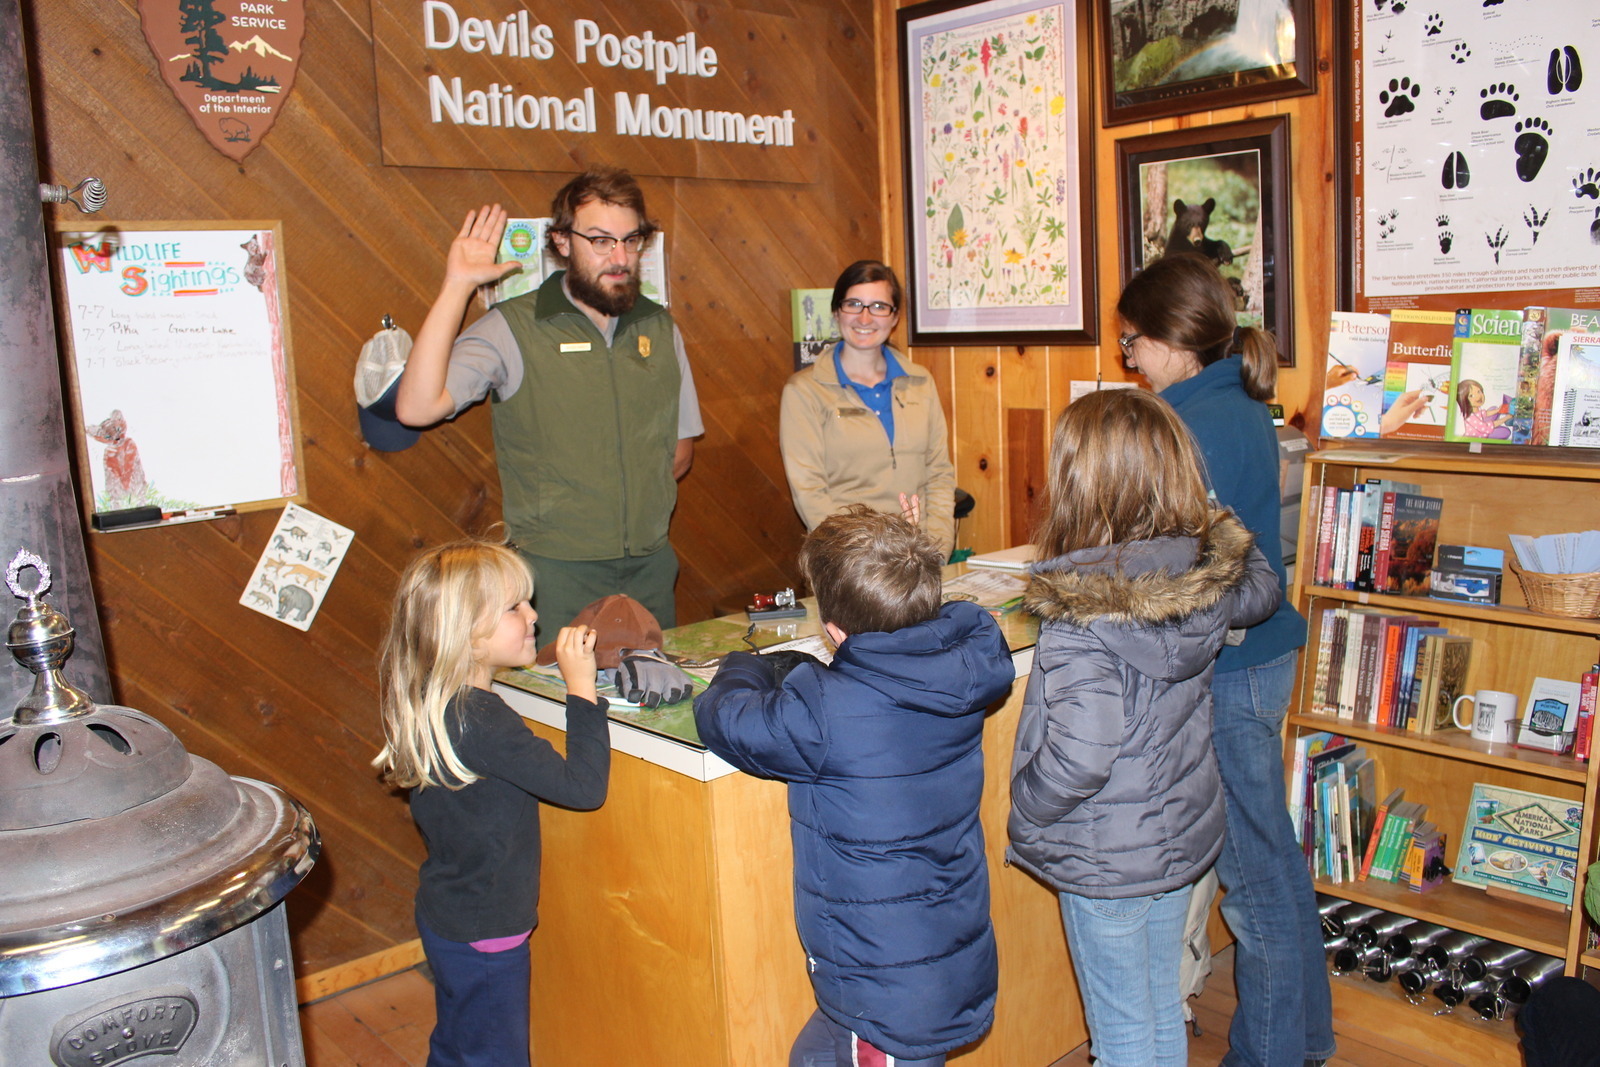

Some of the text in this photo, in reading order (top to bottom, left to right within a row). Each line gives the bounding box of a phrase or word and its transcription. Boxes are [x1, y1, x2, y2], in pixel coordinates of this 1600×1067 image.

[240, 3, 275, 15] PARK
[231, 16, 287, 30] SERVICE
[422, 0, 719, 86] Devils Postpile
[204, 94, 266, 105] Department
[199, 104, 272, 114] of the Interior
[428, 74, 797, 147] National Monument
[70, 241, 181, 274] WILDLIFE
[120, 264, 241, 297] Sightings
[109, 321, 141, 336] Pika
[168, 323, 207, 336] Garnet
[1381, 513, 1393, 529] HIGH
[1379, 529, 1392, 551] SIERRA
[1512, 817, 1553, 832] NATIONAL
[1515, 810, 1554, 825] AMERICA'S
[1519, 825, 1544, 837] PARKS
[1502, 835, 1554, 854] ACTIVITY
[68, 1003, 182, 1050] COMFORT
[89, 1029, 173, 1066] STOVE
